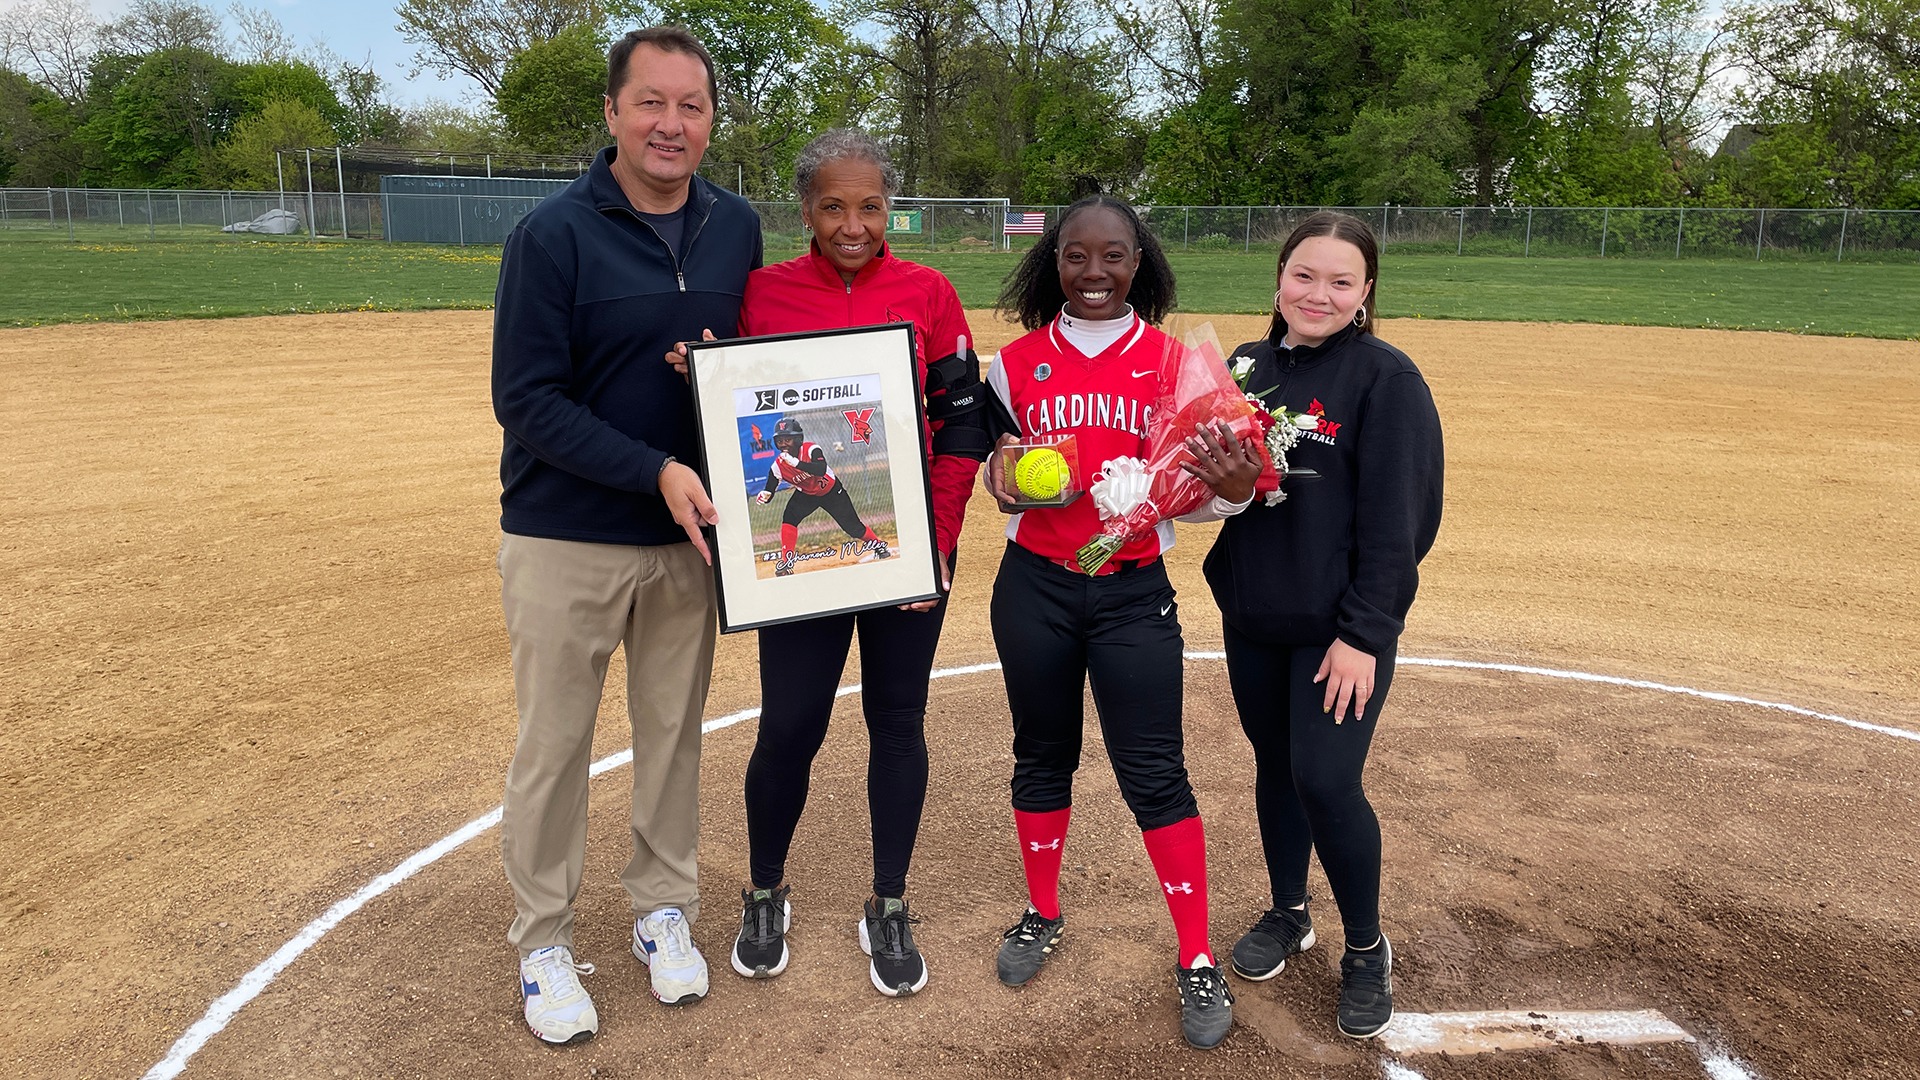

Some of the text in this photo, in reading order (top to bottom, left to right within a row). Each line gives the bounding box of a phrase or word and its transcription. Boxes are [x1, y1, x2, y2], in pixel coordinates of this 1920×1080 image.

[802, 383, 862, 403] SOFTBALL
[1026, 393, 1153, 440] CARDINALS
[1313, 418, 1342, 437] RK
[1296, 430, 1336, 446] OFTBALL
[763, 552, 782, 561] #21
[840, 539, 888, 560] Miller
